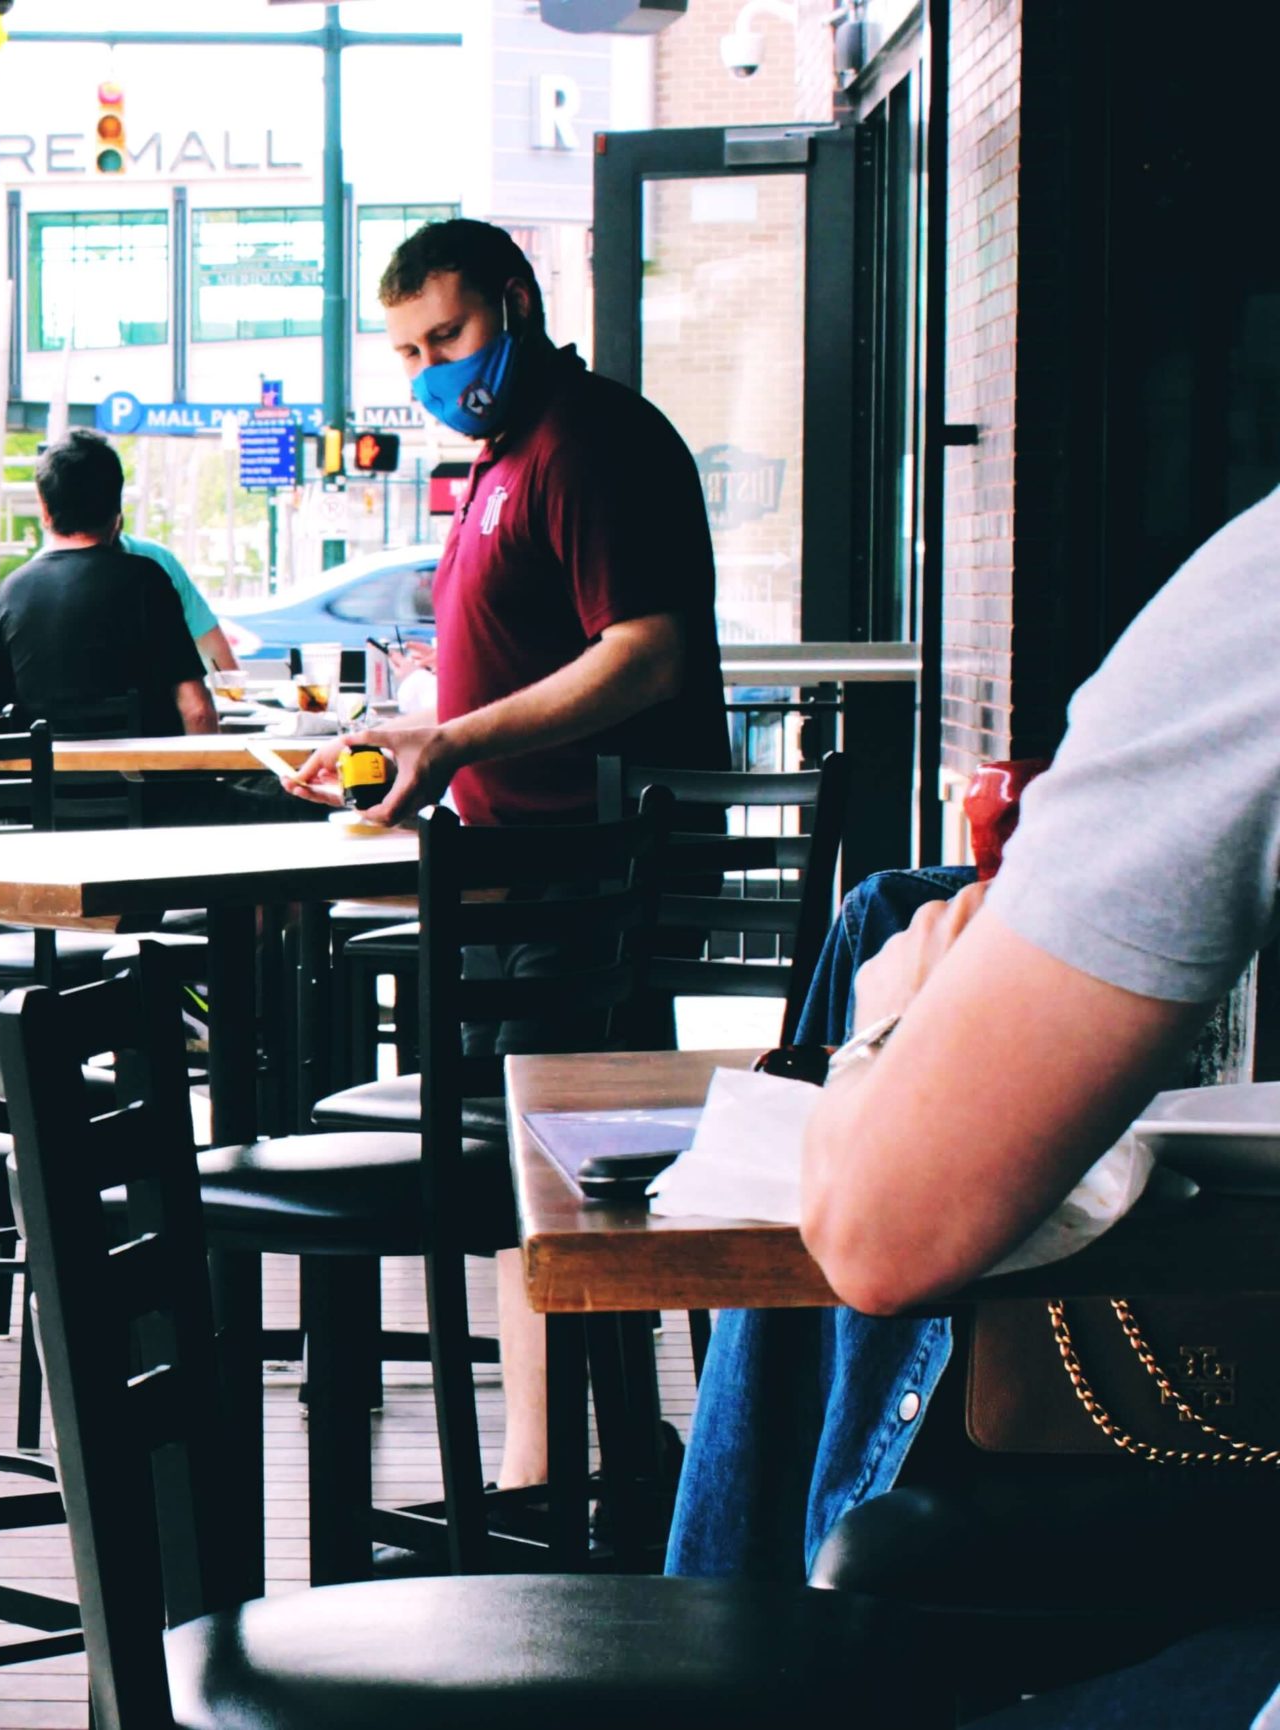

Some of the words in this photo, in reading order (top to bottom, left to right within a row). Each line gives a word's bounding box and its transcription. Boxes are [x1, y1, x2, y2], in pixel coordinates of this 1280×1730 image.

[539, 73, 581, 149] R
[127, 130, 303, 172] MALL
[111, 397, 134, 427] P
[147, 409, 205, 427] MALL
